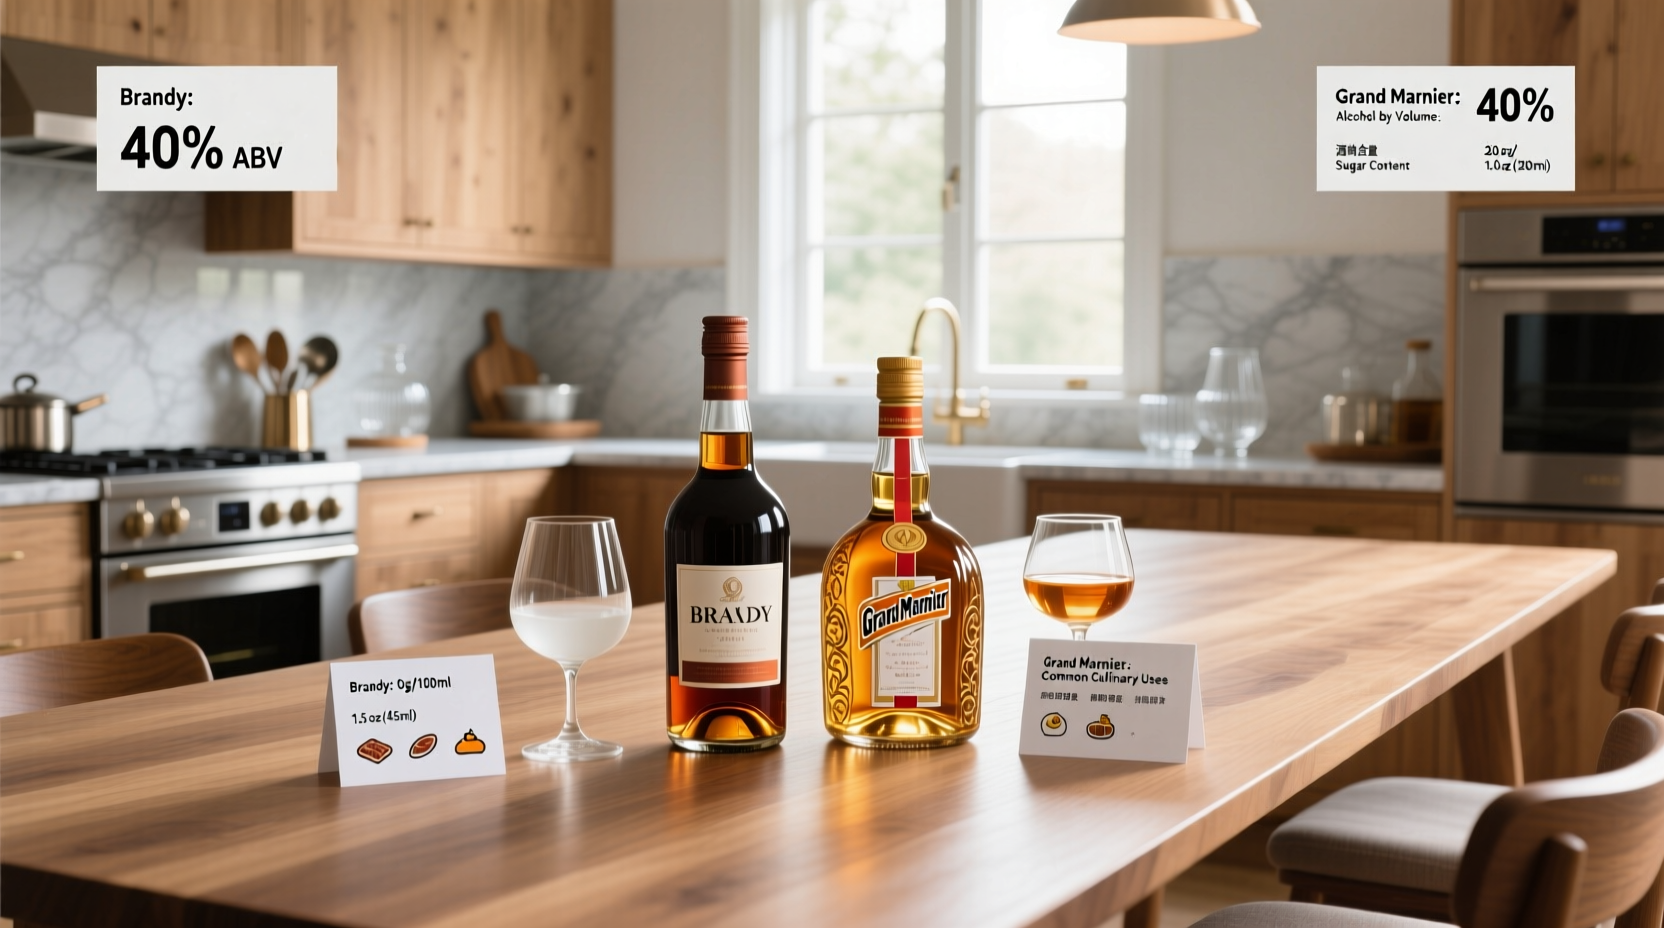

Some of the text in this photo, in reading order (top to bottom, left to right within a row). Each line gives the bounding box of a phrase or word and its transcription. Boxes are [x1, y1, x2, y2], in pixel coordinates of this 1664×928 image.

[1043, 656, 1077, 669] Grand
[349, 675, 452, 695] Brandy: 0g/100ml
[1041, 670, 1088, 682] Common
[1091, 671, 1139, 687] Culinary
